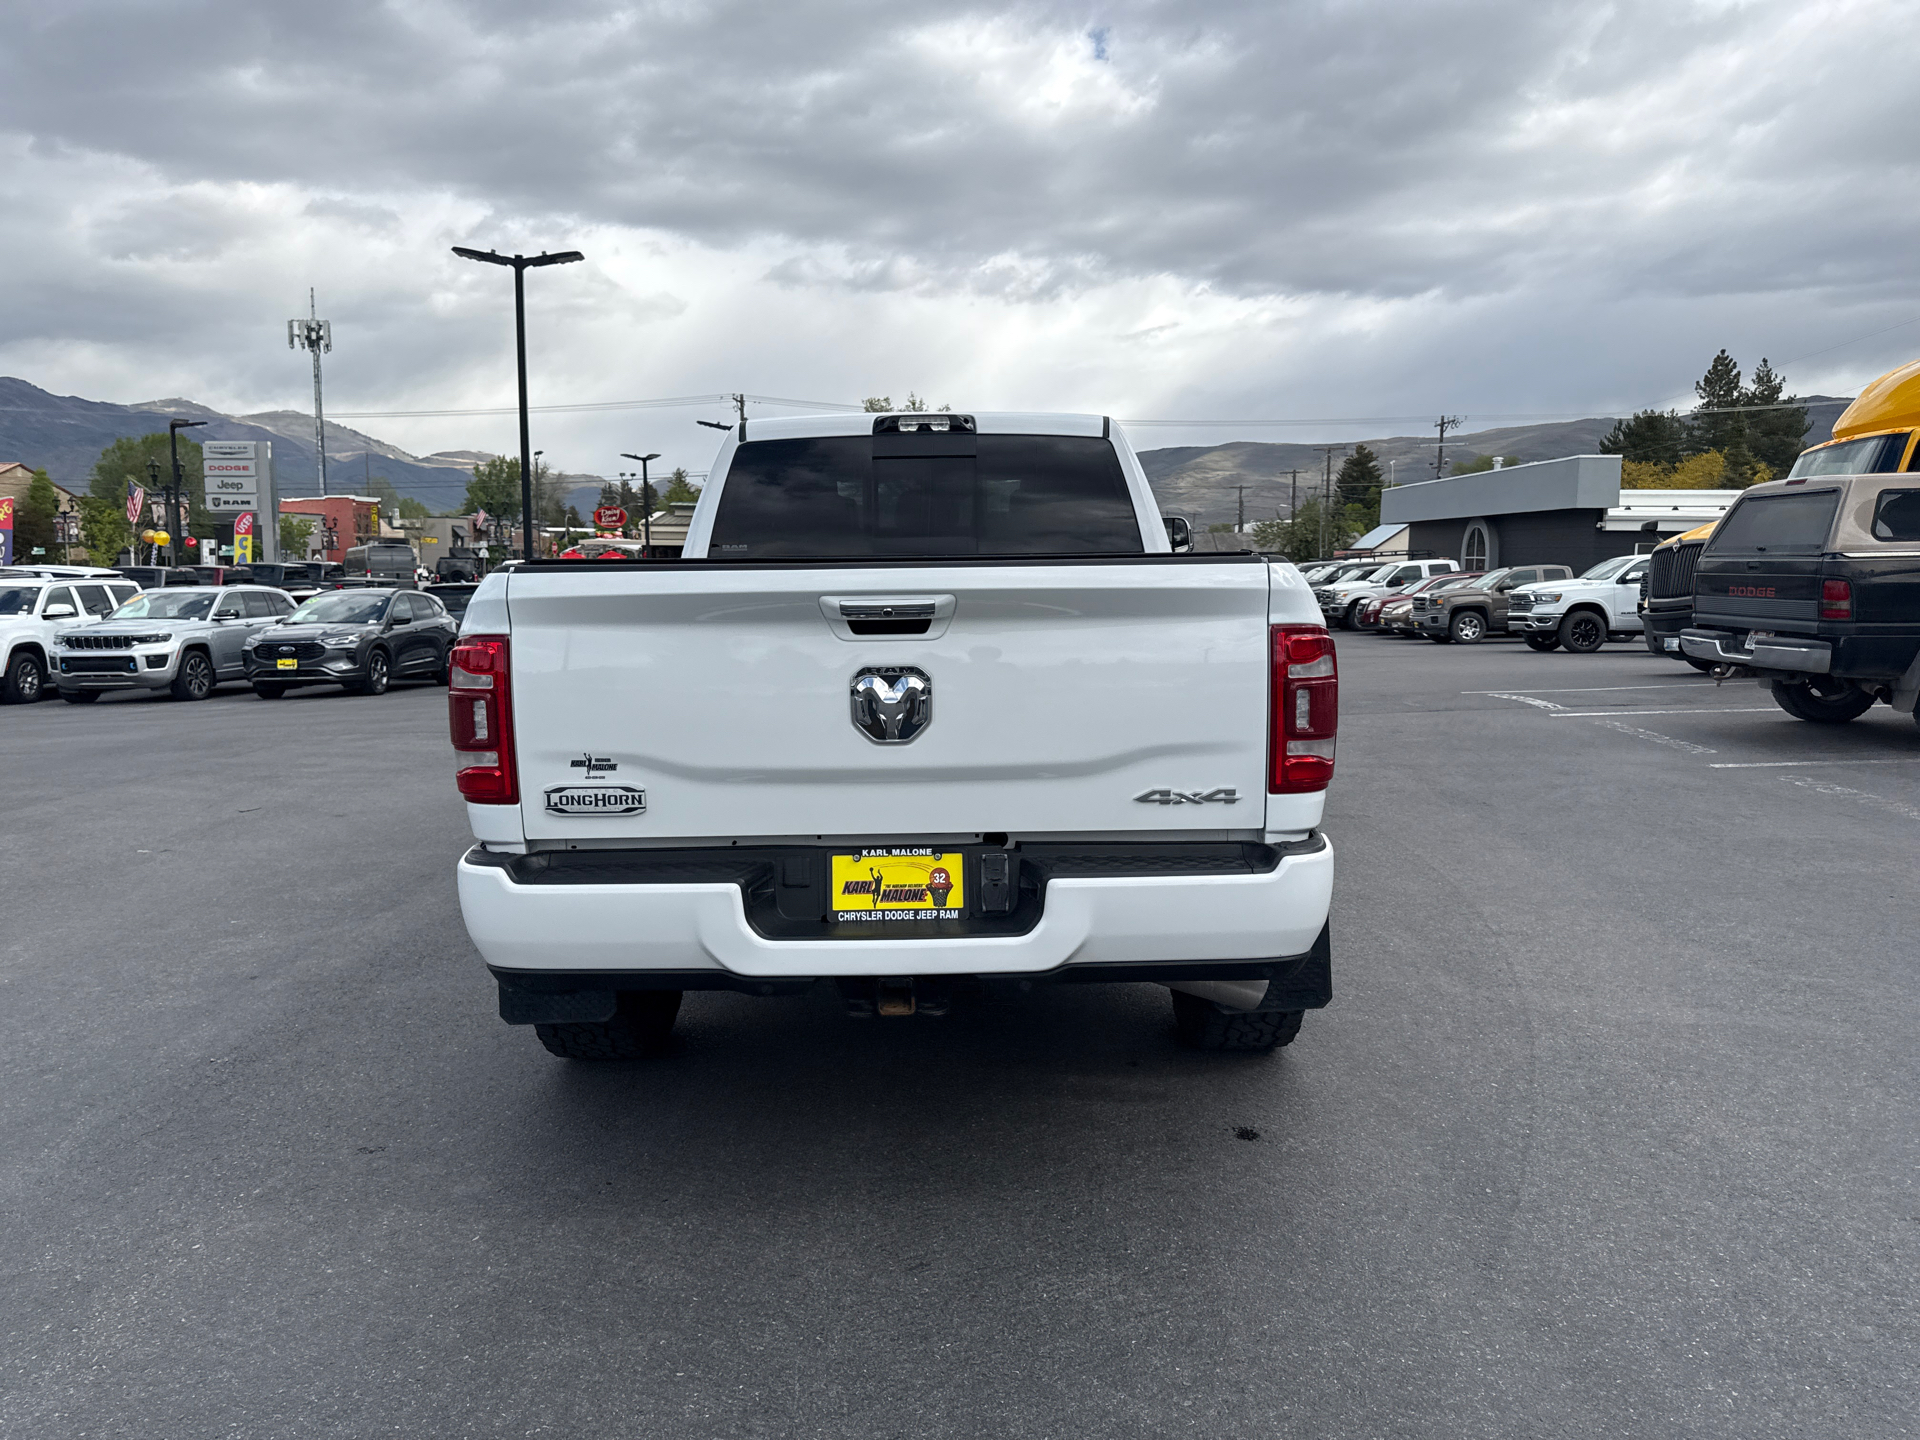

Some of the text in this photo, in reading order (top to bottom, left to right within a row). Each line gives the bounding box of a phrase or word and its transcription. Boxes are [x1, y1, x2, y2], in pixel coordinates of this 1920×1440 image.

[217, 480, 243, 491] Jeep
[236, 515, 252, 533] USED
[1729, 586, 1776, 597] DODGE
[865, 667, 915, 675] RAM
[570, 759, 587, 768] KARL
[591, 763, 618, 771] MALONE
[862, 848, 933, 857] KARL MALONE
[933, 873, 946, 884] 32
[842, 881, 874, 895] KARL
[880, 888, 928, 903] MALONE
[838, 910, 959, 922] CHRYSLER DODGE JEEP RAM
